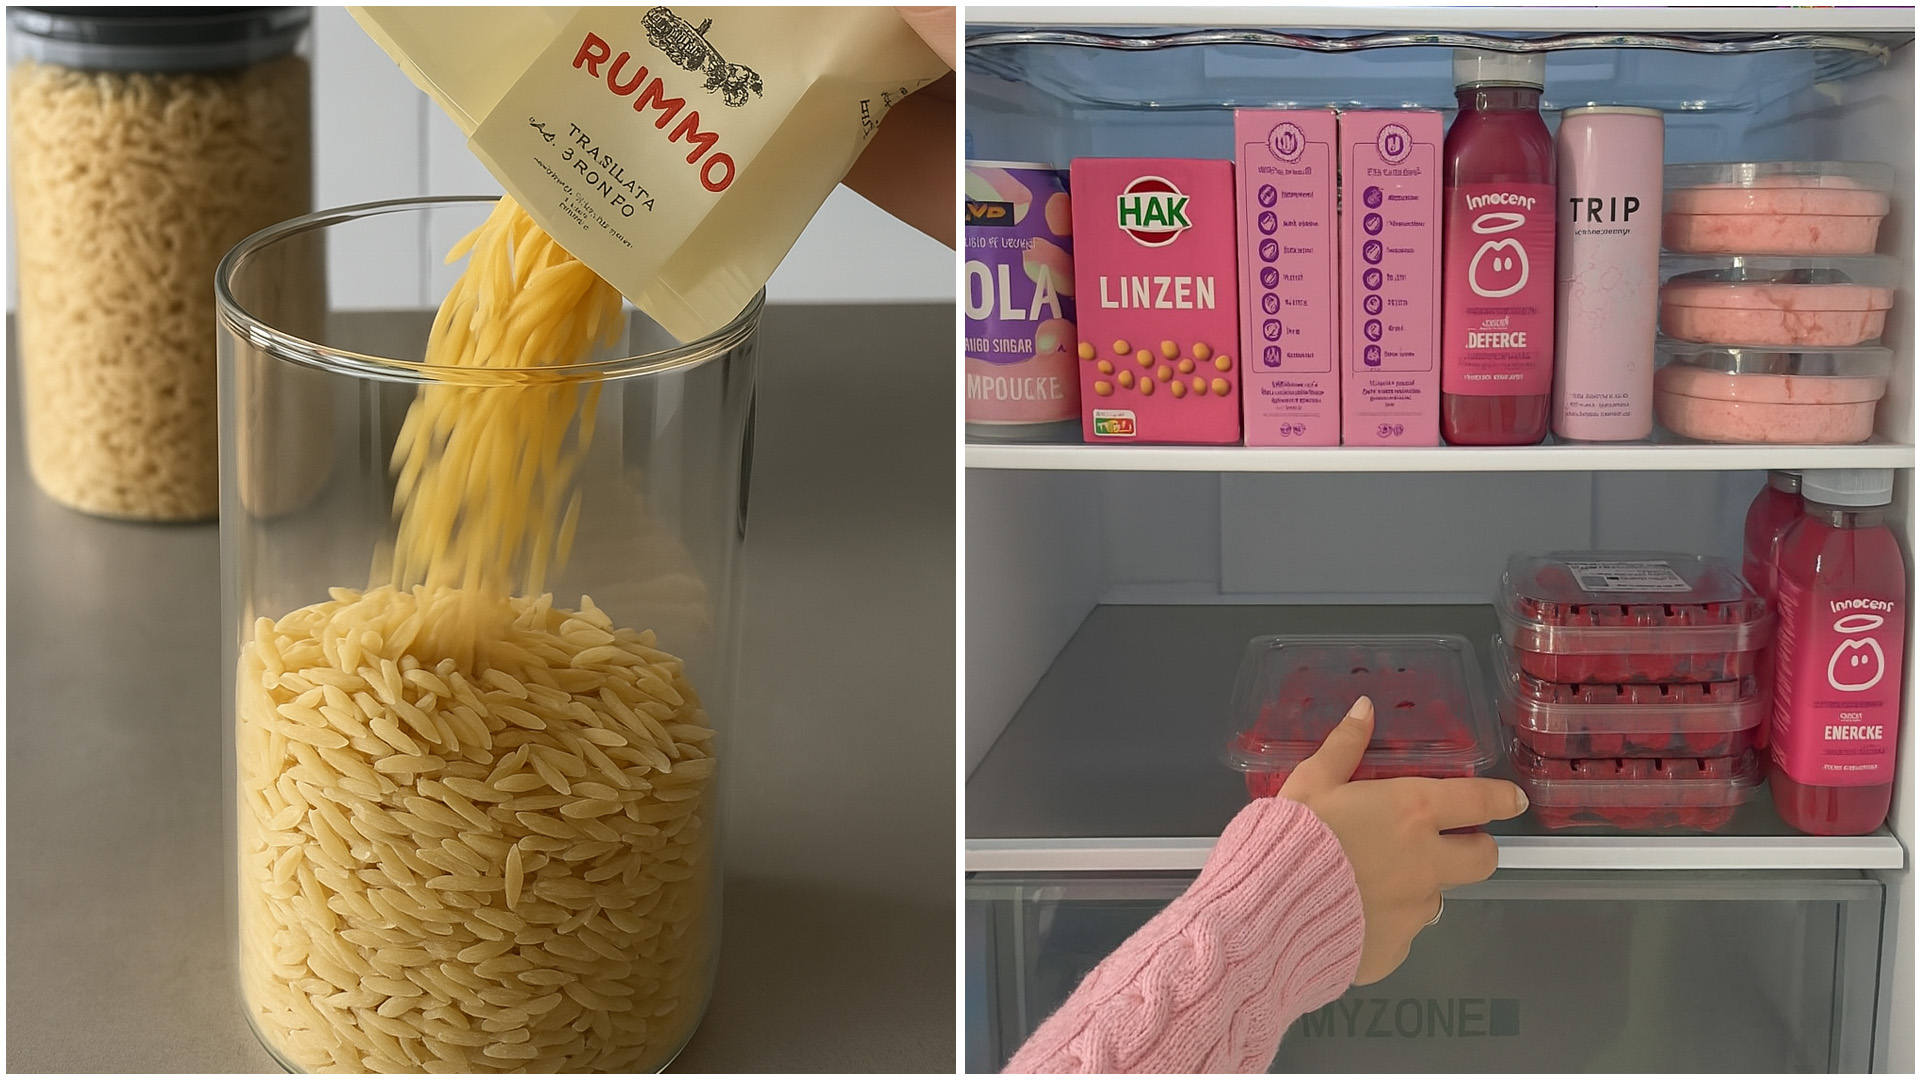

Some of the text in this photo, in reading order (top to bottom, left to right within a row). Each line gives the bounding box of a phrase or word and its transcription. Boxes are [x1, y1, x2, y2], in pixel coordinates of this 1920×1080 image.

[572, 32, 736, 193] RUMMO
[1119, 196, 1190, 227] HAK
[1570, 196, 1640, 223] TRIP
[1099, 276, 1216, 310] LINZEN
[1303, 998, 1487, 1038] MYZONE
